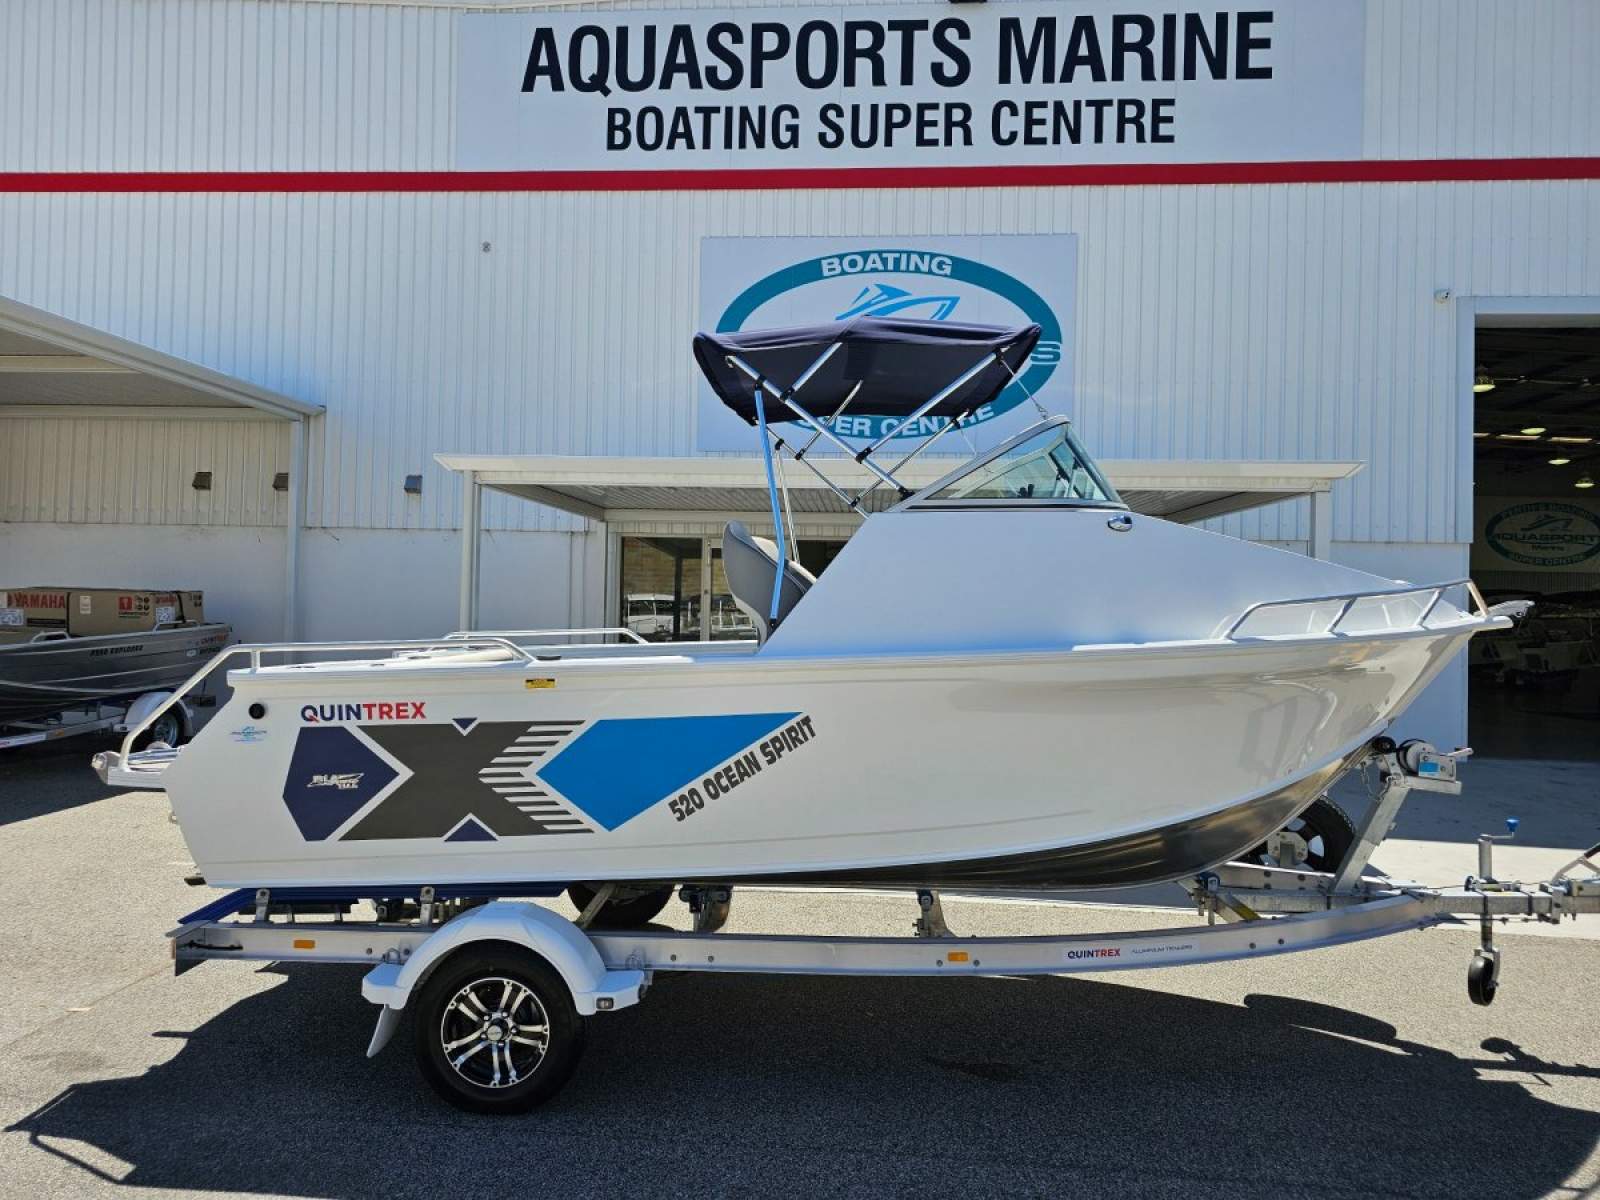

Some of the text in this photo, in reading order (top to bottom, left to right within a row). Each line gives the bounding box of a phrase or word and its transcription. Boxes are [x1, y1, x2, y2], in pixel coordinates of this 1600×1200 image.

[521, 11, 1275, 98] AQUASPORTS MARINE
[606, 98, 1176, 151] BOATING SUPER CENTRE
[820, 252, 953, 277] BOATING
[15, 591, 65, 609] YAMAHA
[300, 702, 426, 723] QUINTREX
[668, 715, 816, 822] 520 OCEAN SPIRIT
[1067, 948, 1121, 960] QUINTREX
